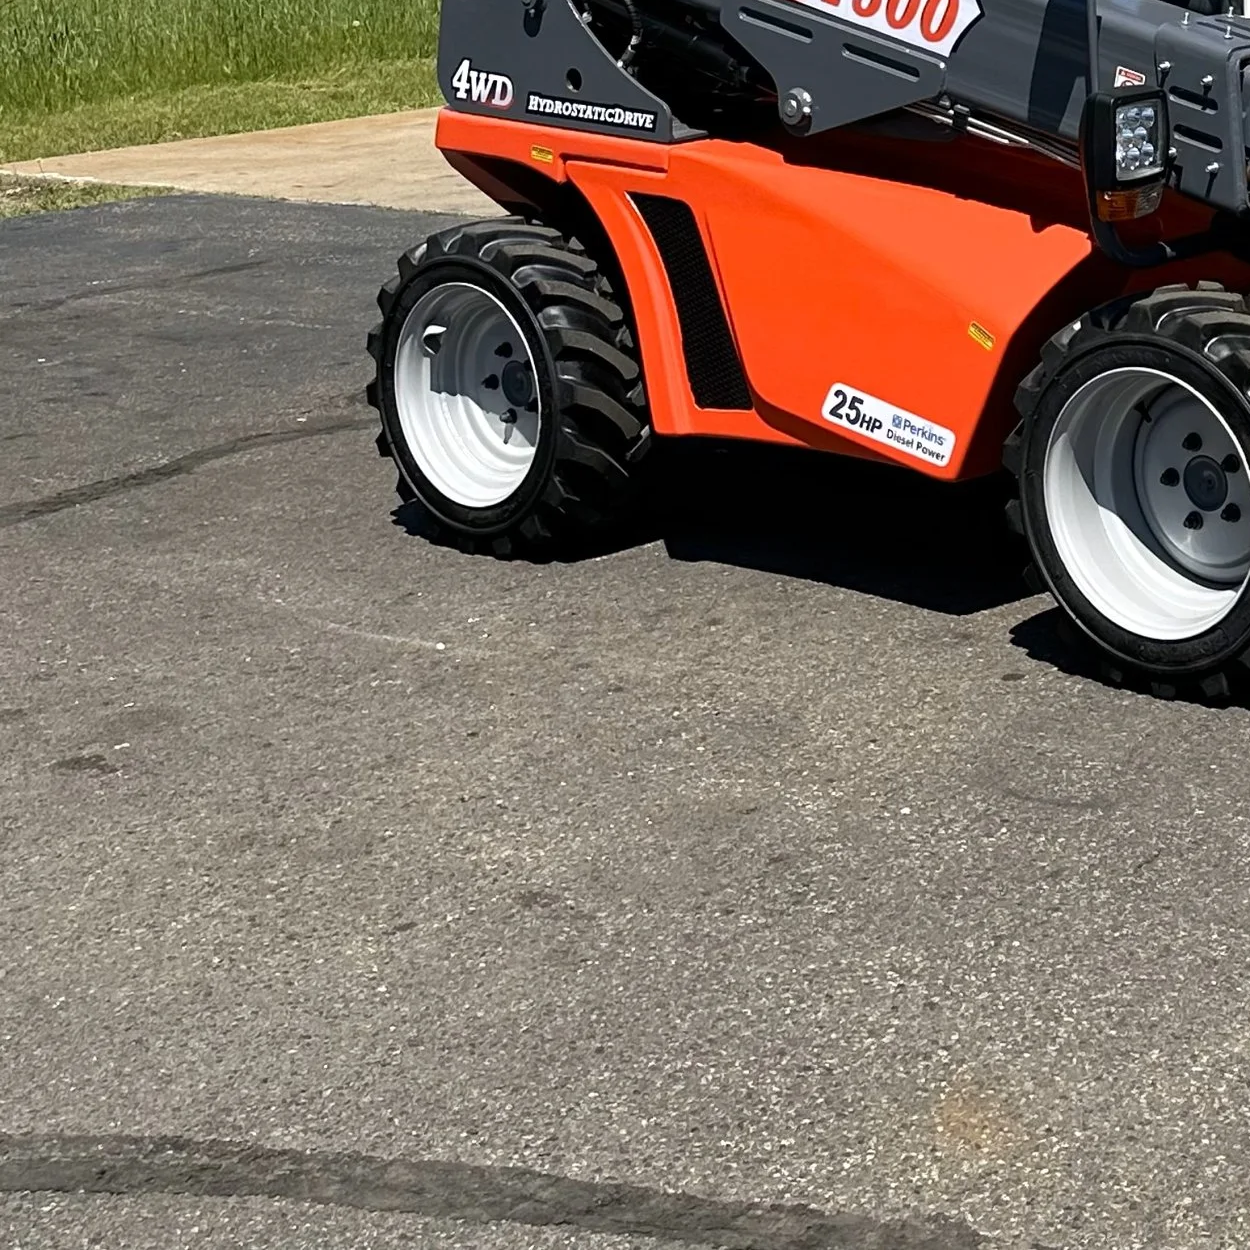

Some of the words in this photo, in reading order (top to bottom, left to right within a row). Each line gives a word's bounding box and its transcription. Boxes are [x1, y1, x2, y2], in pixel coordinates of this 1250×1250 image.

[452, 59, 514, 107] 4WD
[886, 429, 914, 448] Diesel
[916, 441, 945, 462] Power
[903, 418, 945, 446] Perkins
